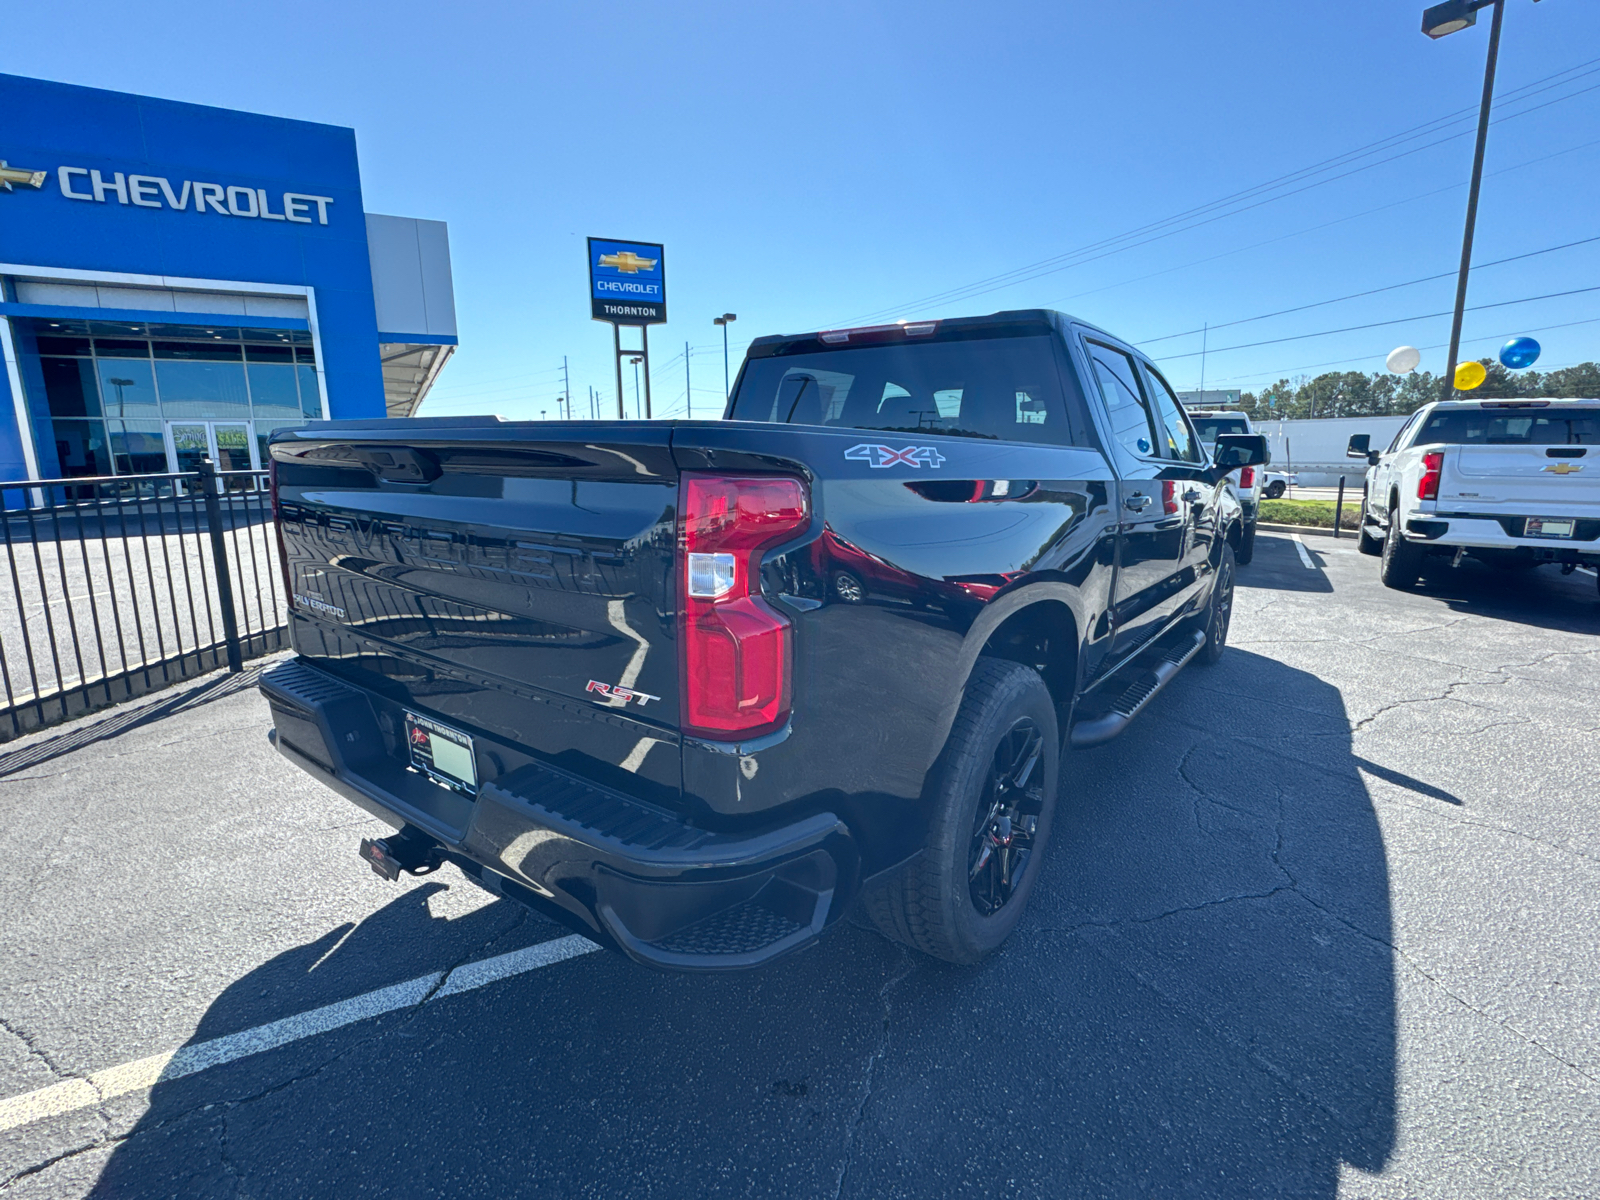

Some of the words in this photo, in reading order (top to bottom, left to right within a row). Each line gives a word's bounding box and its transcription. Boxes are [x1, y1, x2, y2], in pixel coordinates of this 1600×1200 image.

[58, 165, 334, 225] CHEVROLET
[597, 280, 659, 294] CHEVROLET
[604, 305, 656, 316] THORNTON
[280, 504, 616, 584] CHEVROLET
[292, 593, 345, 618] SILVERADO
[585, 679, 661, 706] RST
[416, 717, 433, 729] JOHN
[433, 723, 468, 745] THORNTON
